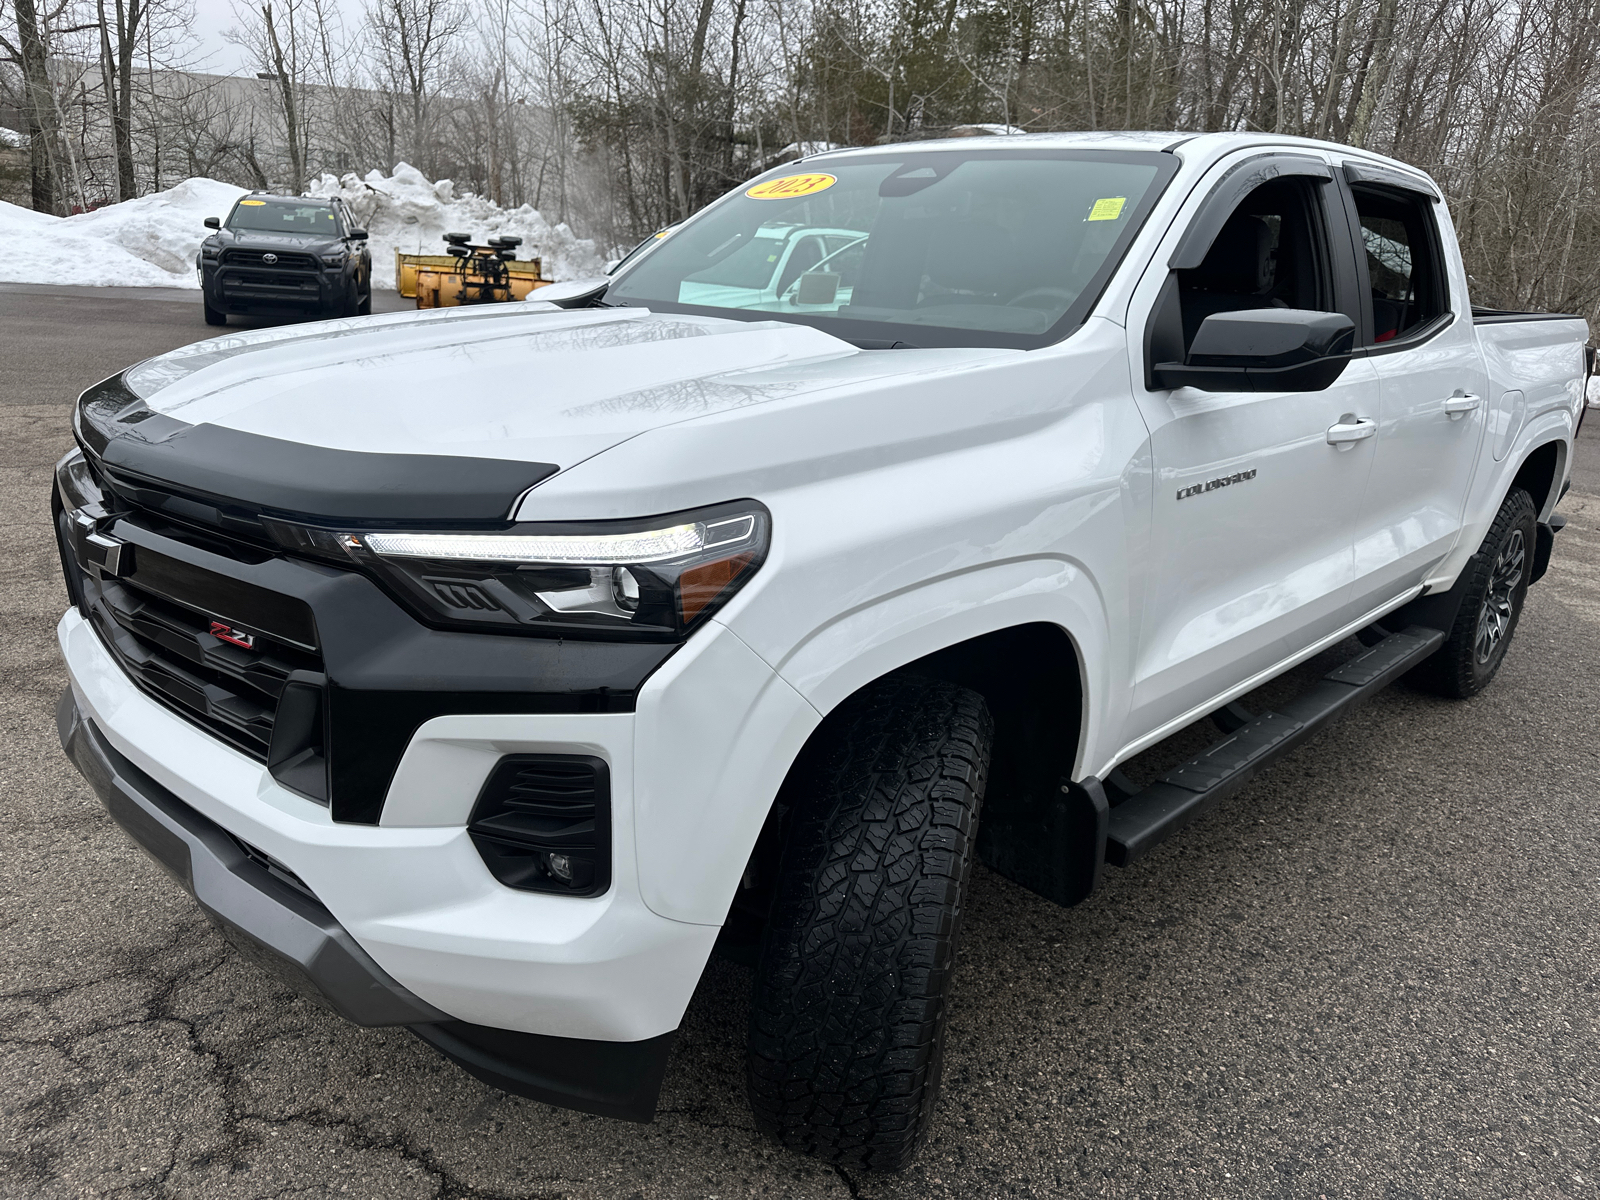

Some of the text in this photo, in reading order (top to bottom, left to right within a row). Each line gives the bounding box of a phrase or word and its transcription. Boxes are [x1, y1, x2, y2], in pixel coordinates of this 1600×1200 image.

[753, 177, 826, 194] 2023
[1176, 468, 1257, 500] COLORADO
[210, 621, 254, 649] Z71
